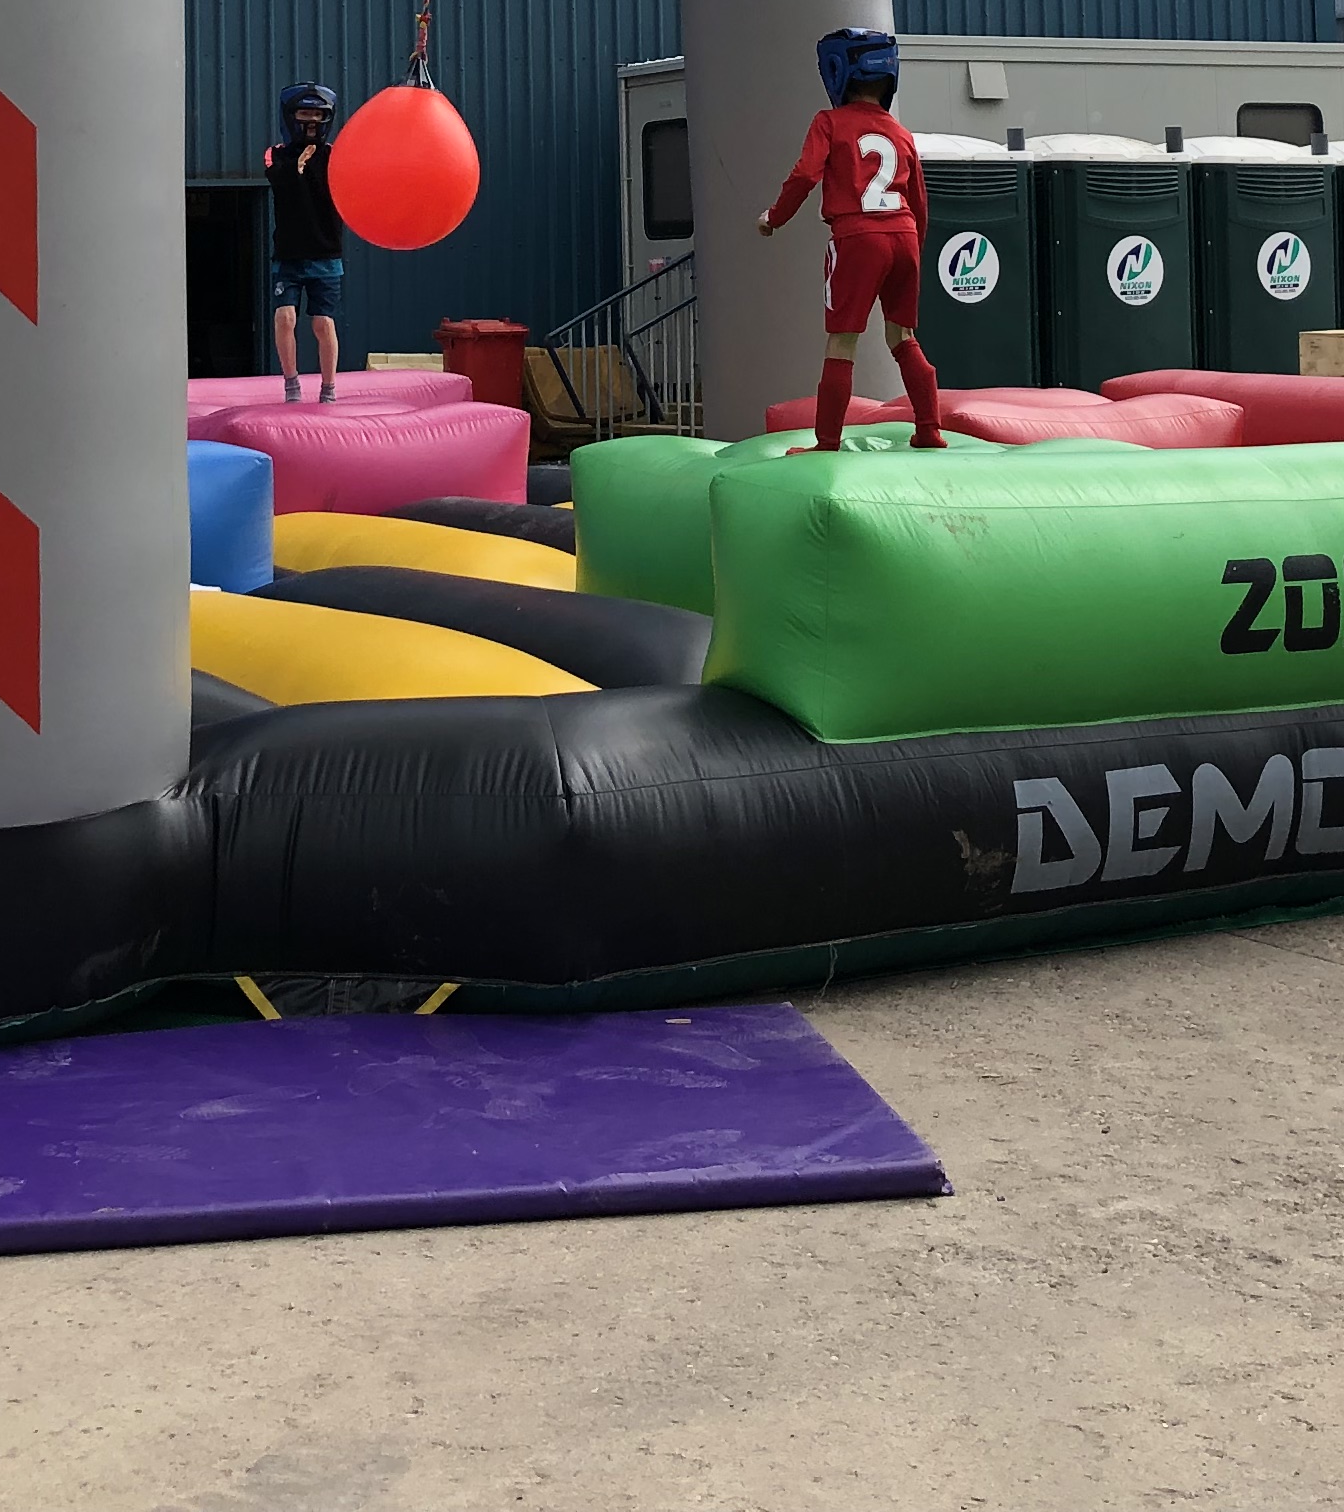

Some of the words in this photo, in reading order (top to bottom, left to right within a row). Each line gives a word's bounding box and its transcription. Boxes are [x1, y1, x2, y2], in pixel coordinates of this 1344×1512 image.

[857, 133, 902, 212] 2
[952, 277, 987, 286] NIXON
[1269, 275, 1300, 283] NIXON
[1119, 281, 1152, 290] NIXON
